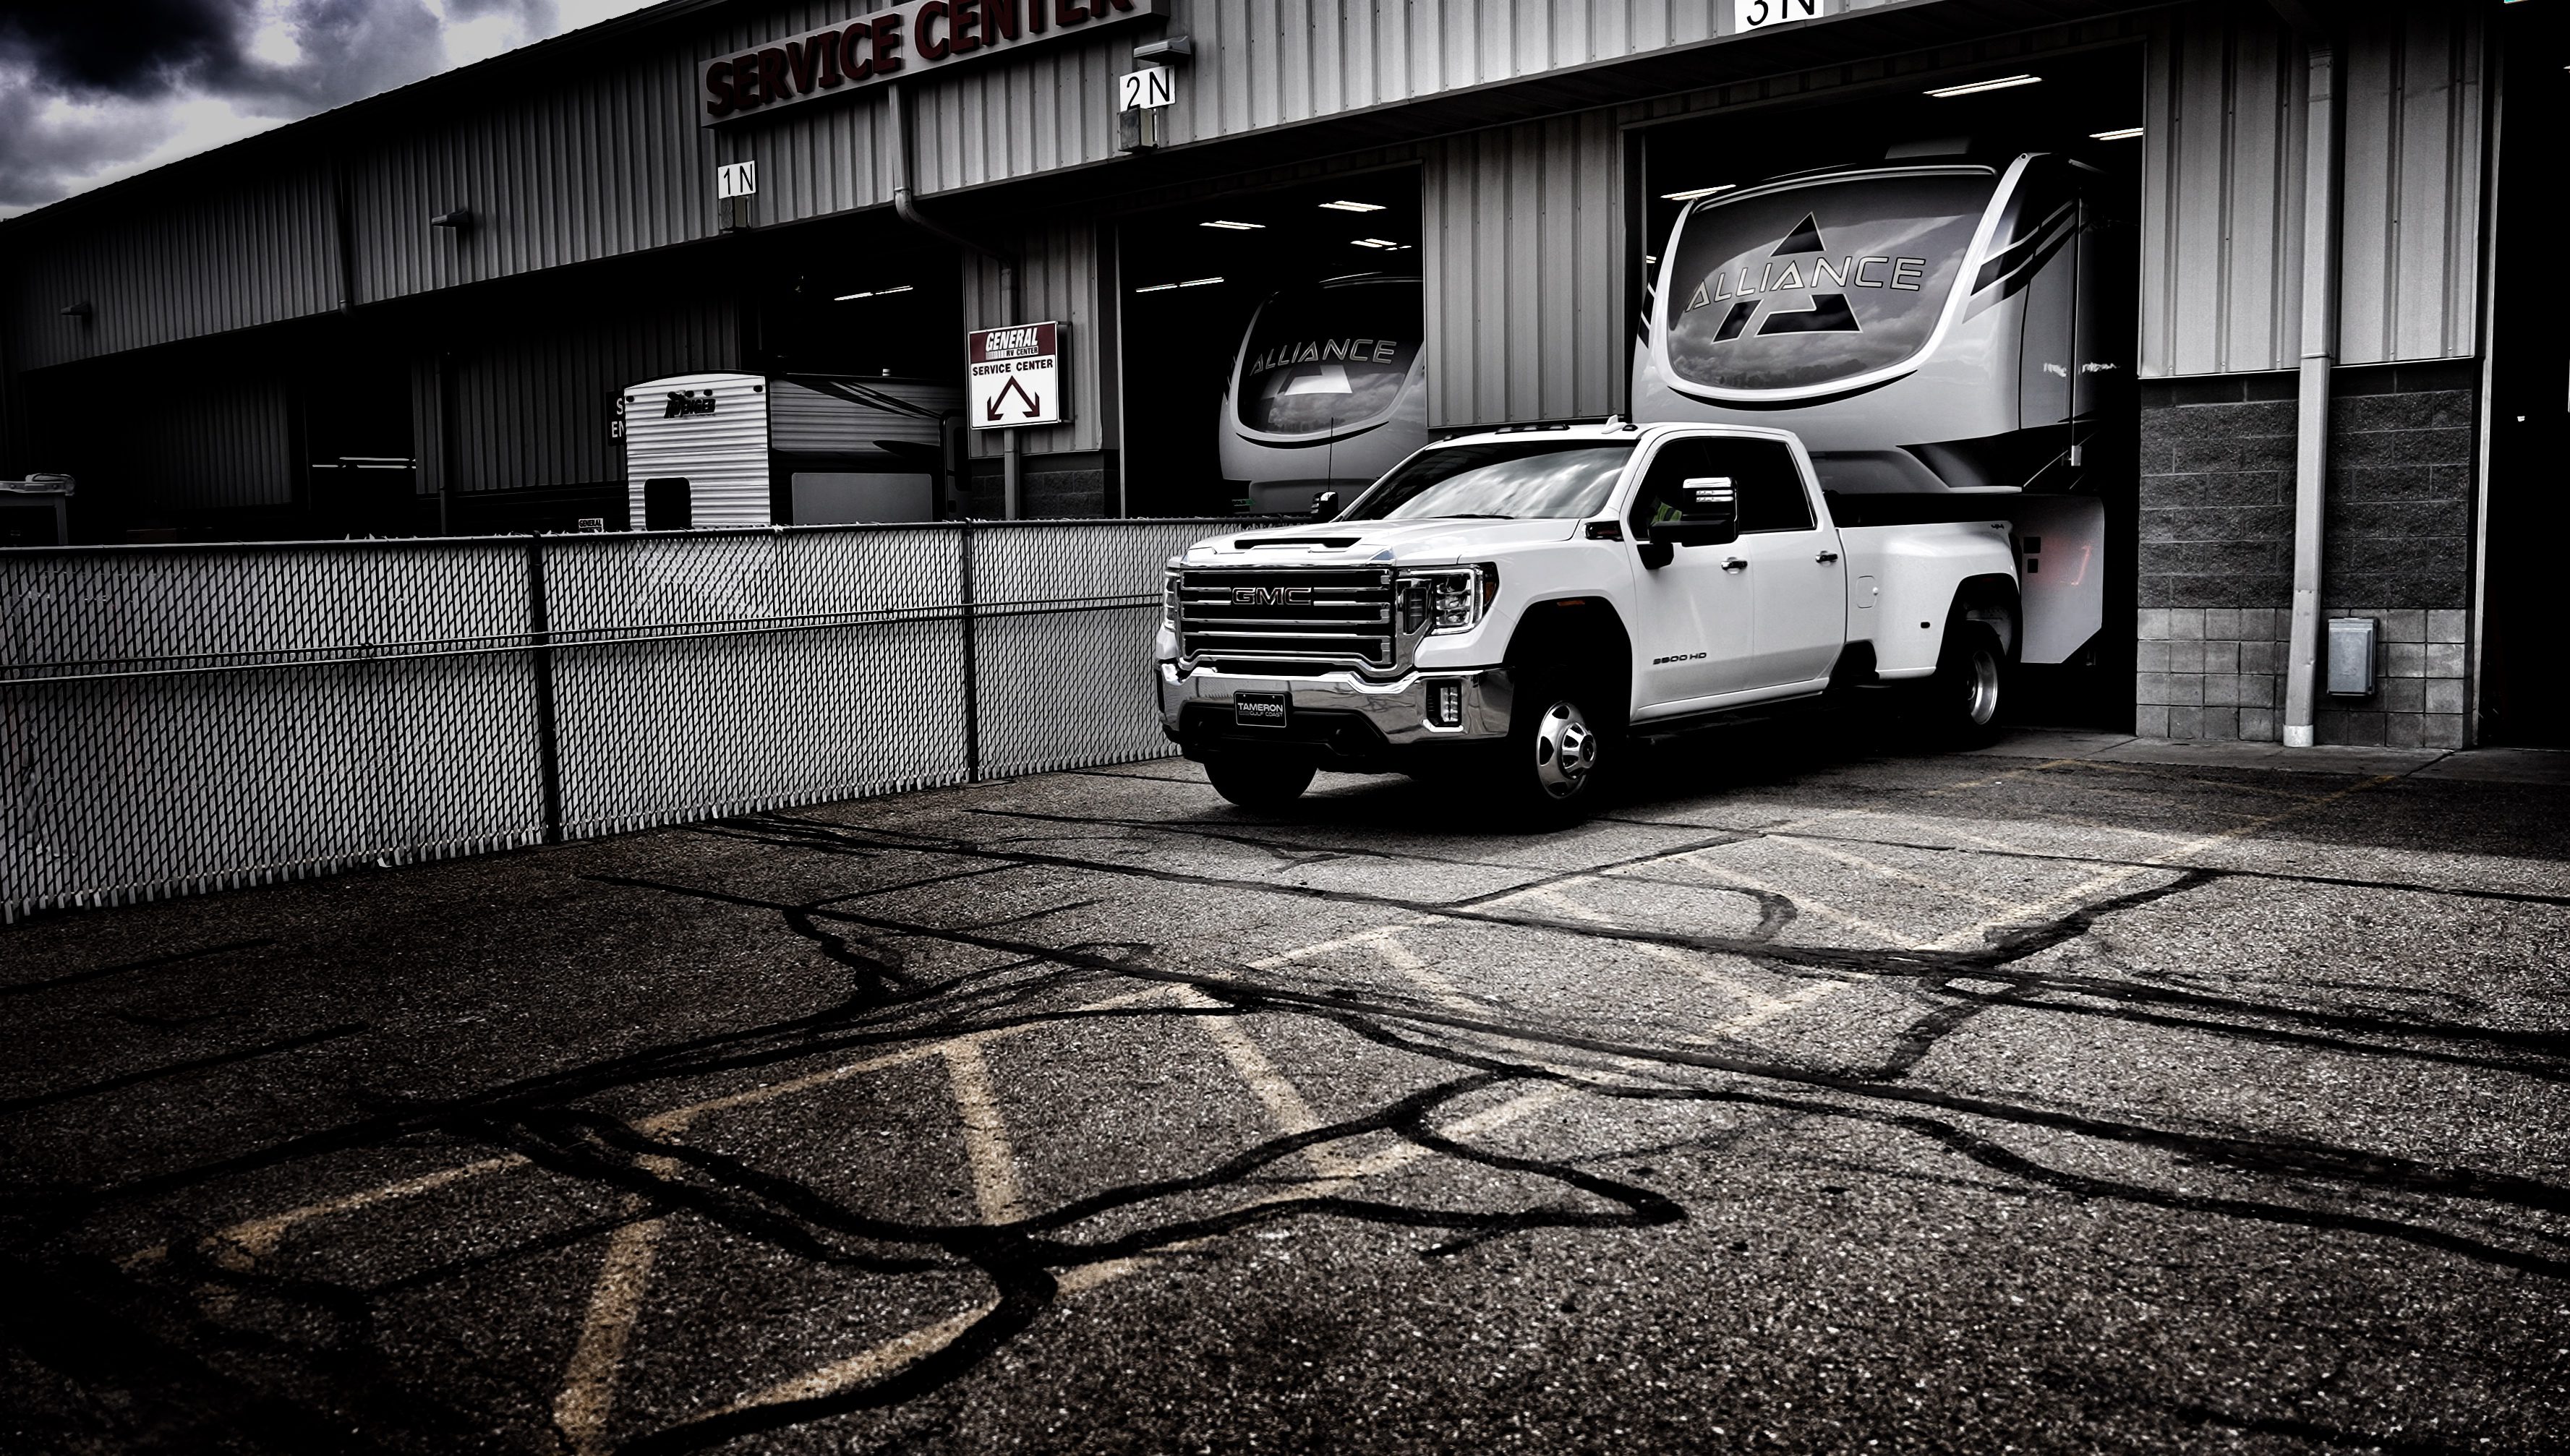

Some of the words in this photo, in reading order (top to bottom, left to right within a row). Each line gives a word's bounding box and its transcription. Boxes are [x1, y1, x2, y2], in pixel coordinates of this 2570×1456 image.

[705, 12, 904, 116] SERVICE
[913, 0, 1134, 61] CENT
[1685, 255, 1926, 313] ALLIANCE
[986, 327, 1038, 351] GENERAL
[1016, 346, 1038, 356] CENTER
[1250, 338, 1397, 376] ALLIANCE
[973, 363, 1011, 376] SERVICE
[1016, 359, 1054, 372] CENTER
[1232, 587, 1312, 605] GMC
[1237, 703, 1283, 711] TAMERON
